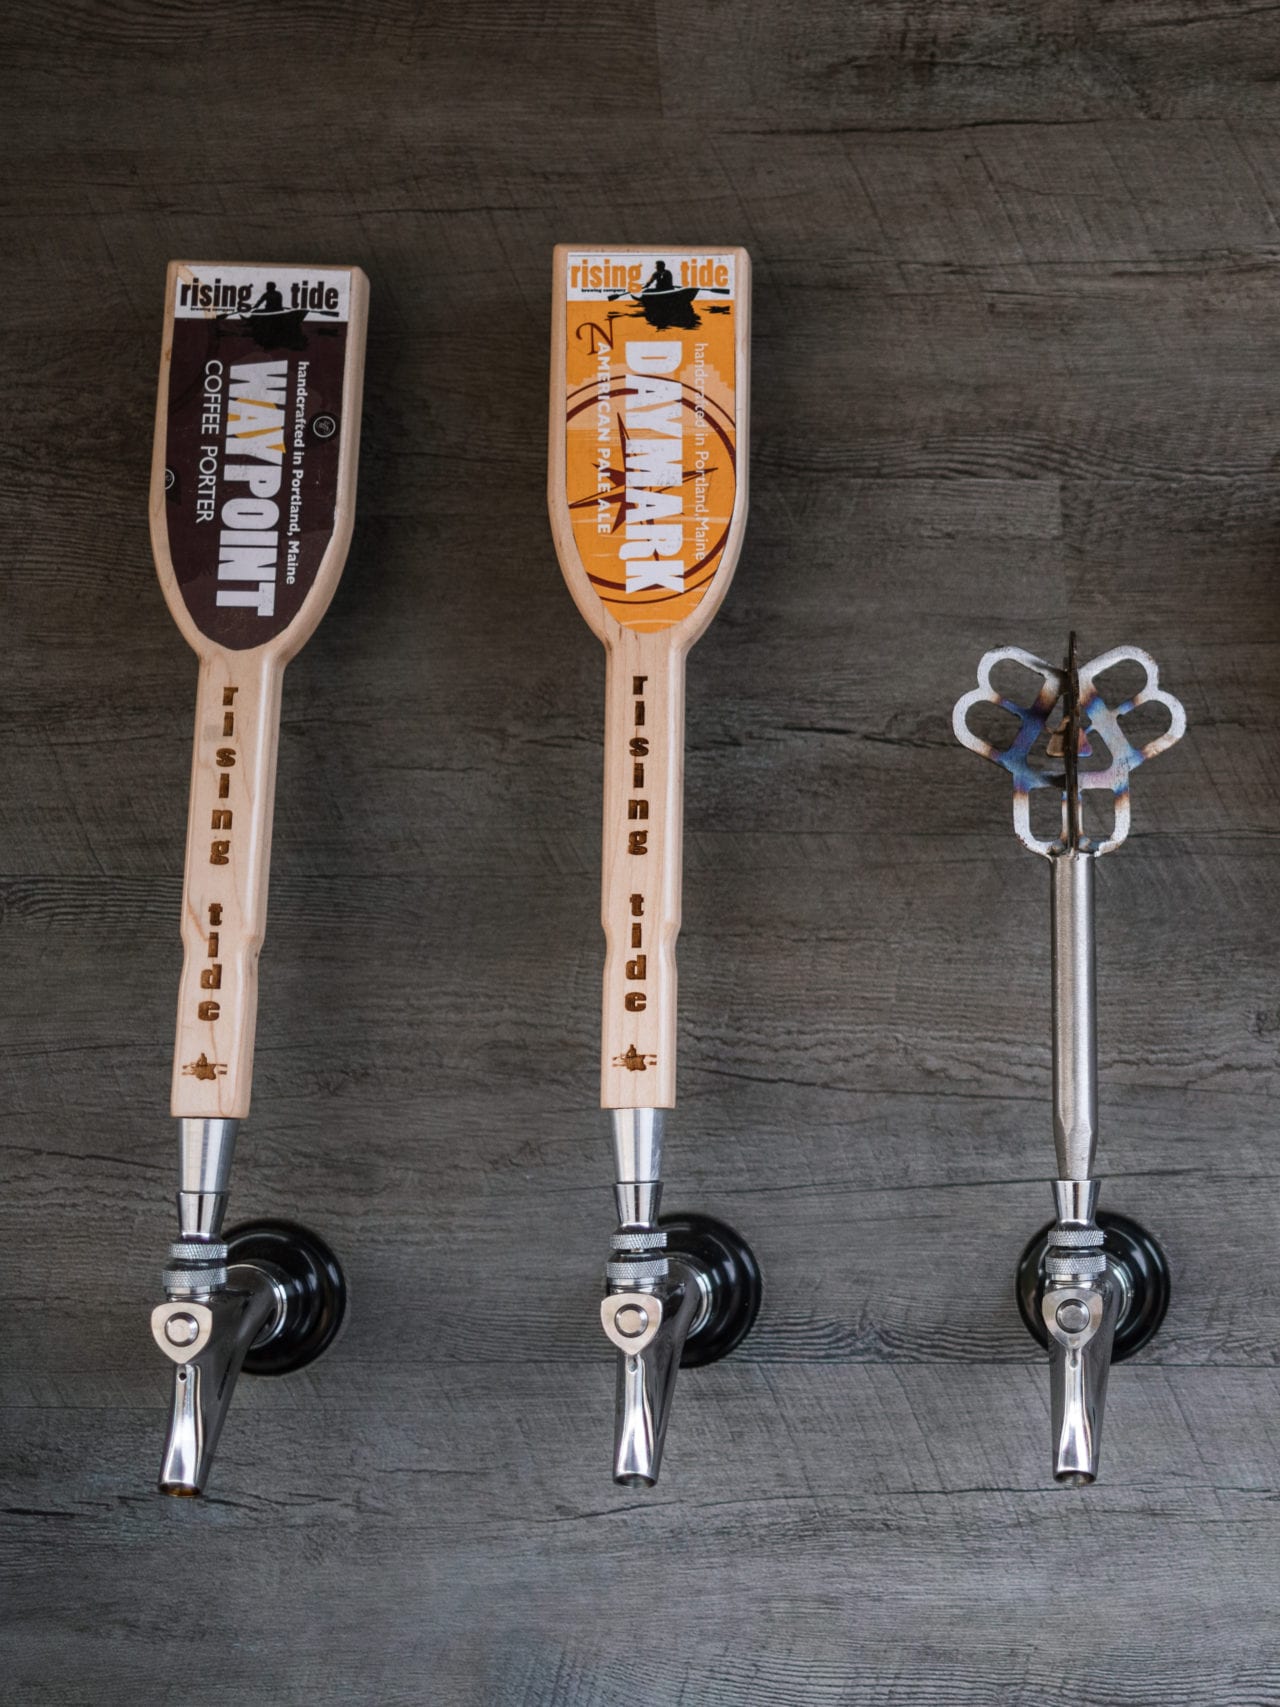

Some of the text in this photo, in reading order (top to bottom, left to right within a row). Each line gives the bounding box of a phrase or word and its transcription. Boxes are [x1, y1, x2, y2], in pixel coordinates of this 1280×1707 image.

[180, 278, 339, 313] rising tide
[570, 258, 729, 293] rising tide
[195, 360, 223, 524] COFFEE PORTER
[286, 361, 310, 585] handcrafted in Portland, Maine
[597, 342, 611, 534] AMERICAN PALE ALE
[619, 341, 685, 594] DAYMARK
[694, 343, 709, 428] handcrafted
[694, 433, 706, 446] in
[215, 360, 289, 617] WAYPOINT
[197, 687, 239, 1022] rising tide
[624, 676, 649, 1012] rising tide
